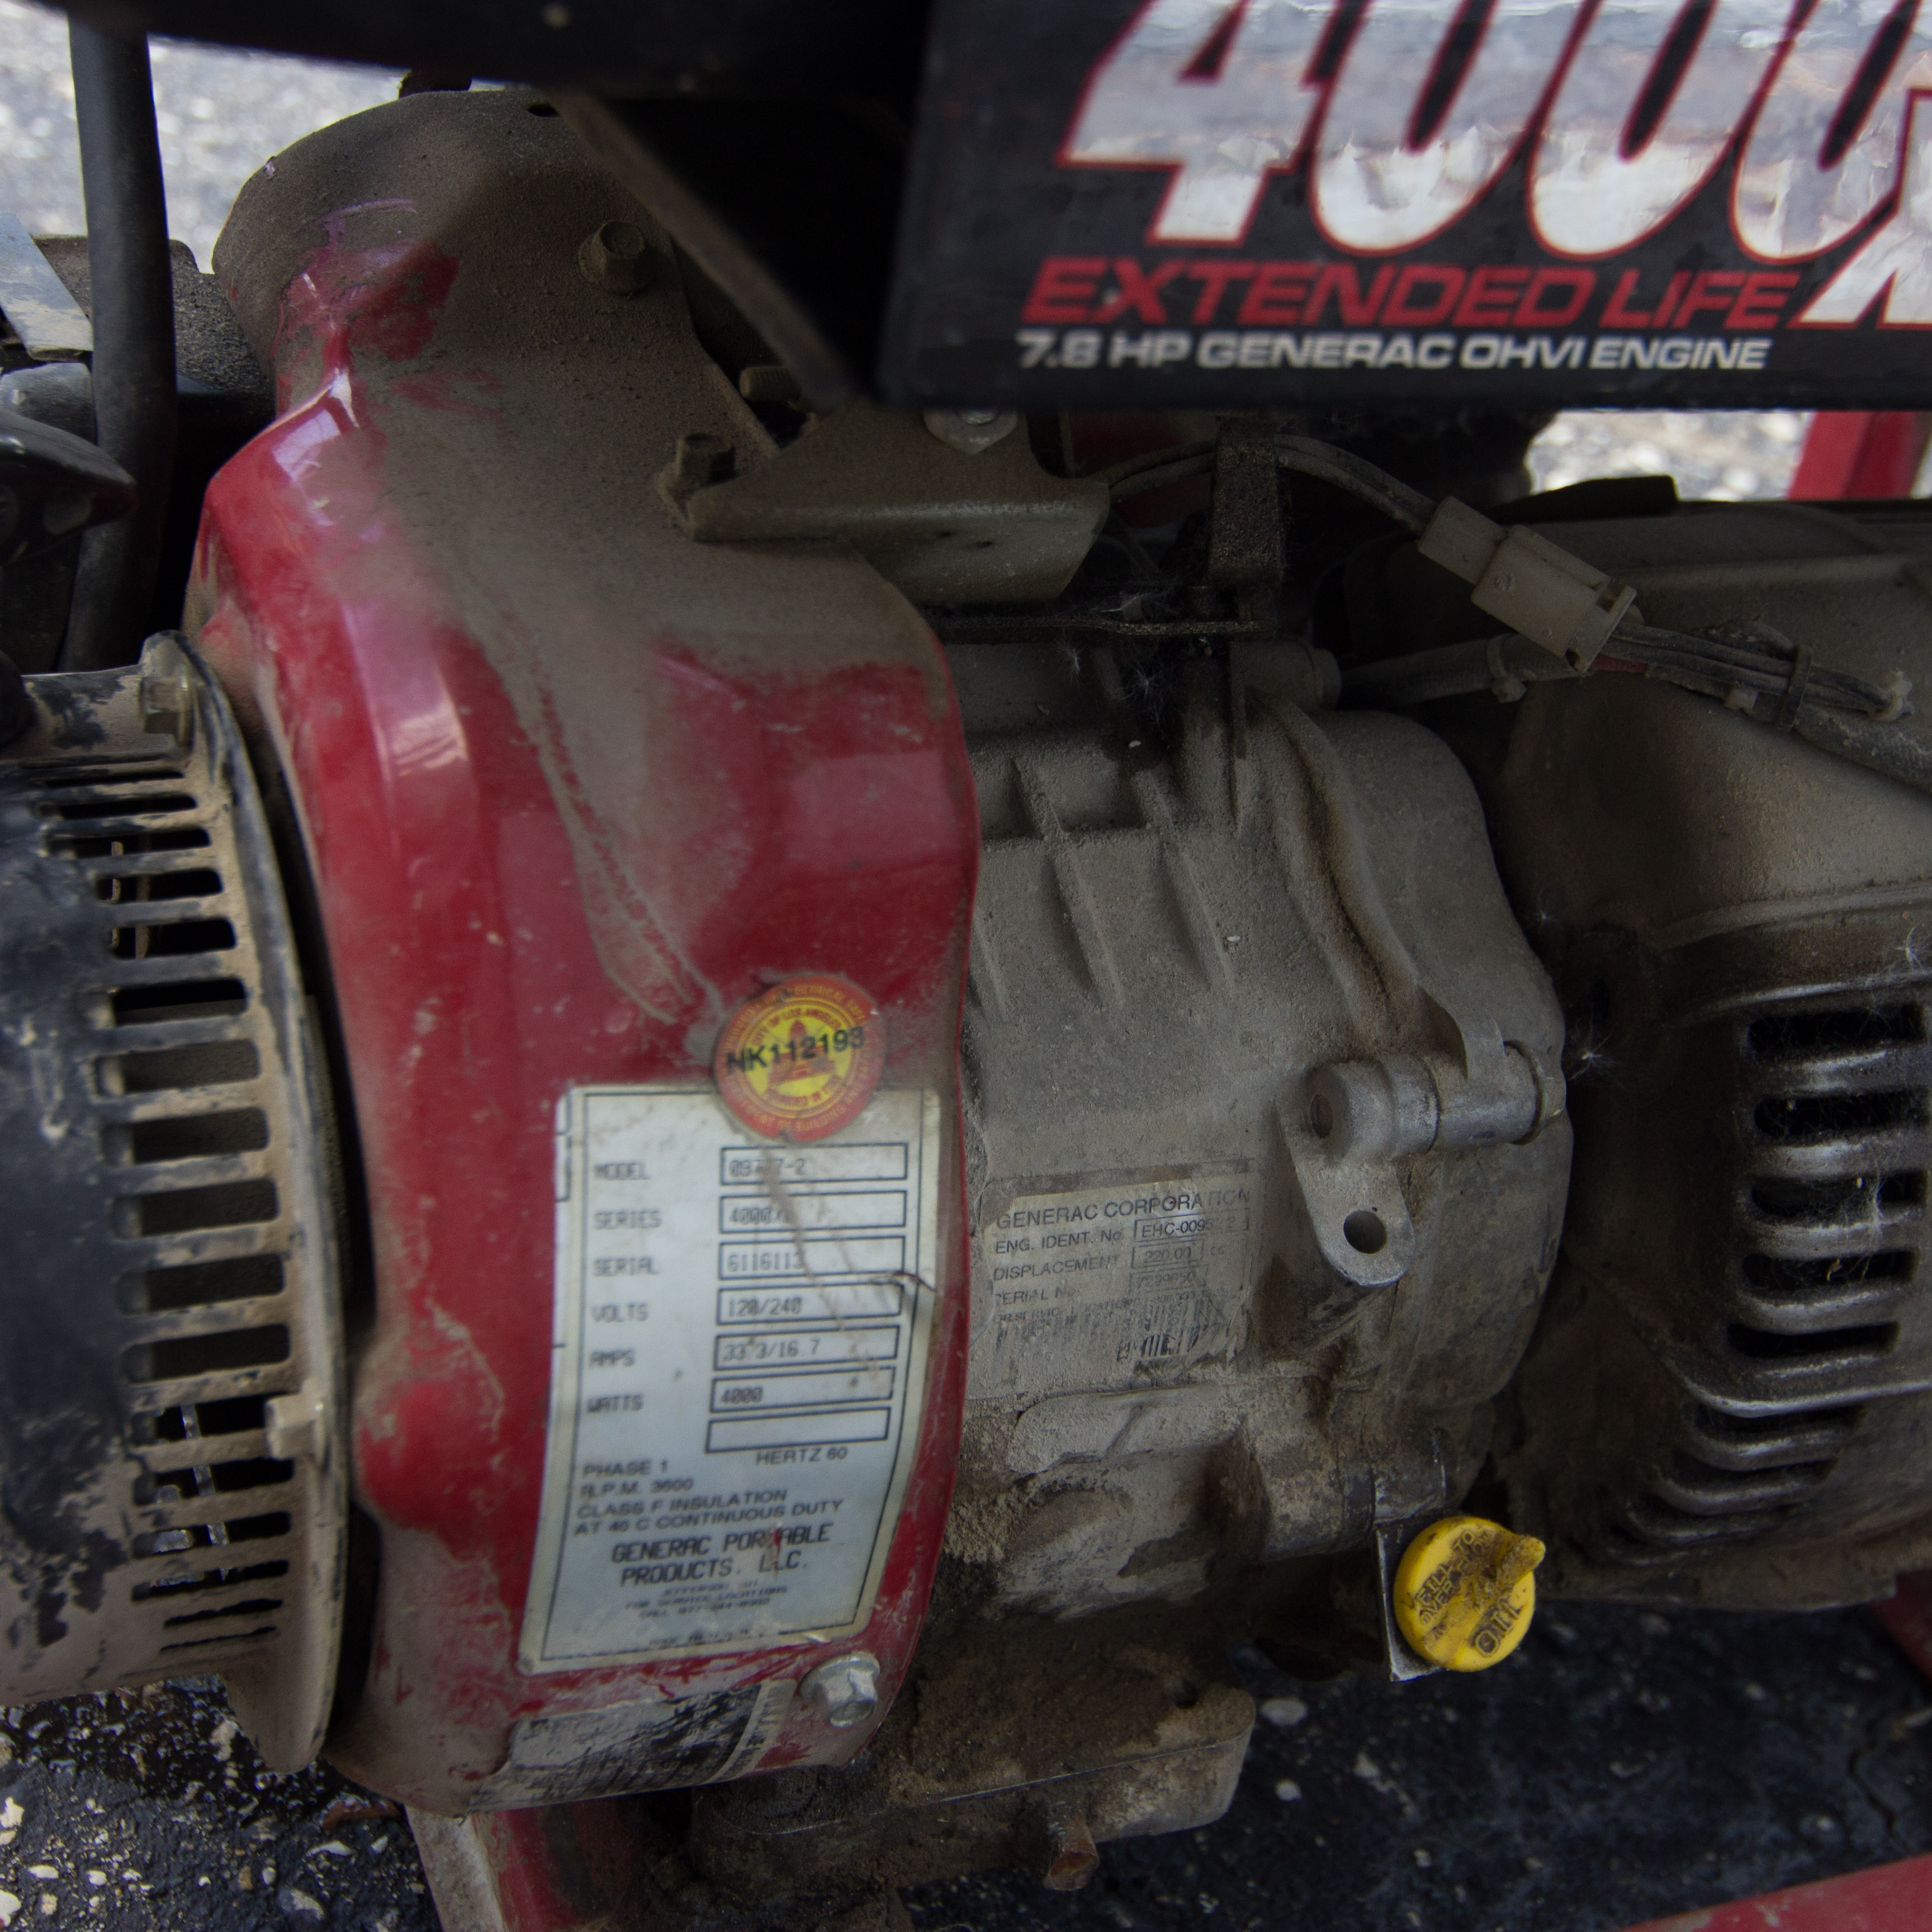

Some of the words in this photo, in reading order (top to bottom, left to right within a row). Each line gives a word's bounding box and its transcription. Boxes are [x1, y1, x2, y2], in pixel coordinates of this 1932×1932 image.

[1021, 254, 1598, 326] EXTENDED
[1599, 268, 1799, 329] LIFE
[1017, 330, 1101, 369] 7.8
[1108, 330, 1191, 369] HP
[1196, 331, 1455, 370] GENERAC
[1460, 334, 1583, 370] OHVI
[1589, 335, 1773, 370] ENGINE
[727, 1026, 866, 1076] NK112193
[594, 1159, 650, 1181] MODEL
[594, 1209, 661, 1230] SERIES
[997, 1204, 1098, 1229] GENERAC
[1104, 1188, 1250, 1218] CORPORATION
[996, 1238, 1034, 1254] ENG.
[1041, 1231, 1093, 1249] IDENT.
[594, 1257, 660, 1277] SERIAL
[993, 1254, 1120, 1281] DISPLACEMENT
[591, 1301, 649, 1323] VOLTS
[728, 1295, 803, 1317] 120/240
[590, 1347, 636, 1367] AMPS
[586, 1394, 644, 1414] WATTS
[721, 1386, 764, 1405] 4000
[756, 1447, 821, 1466] HERTZ
[583, 1460, 652, 1478] PHASE
[577, 1500, 645, 1521] CLASS
[651, 1499, 665, 1514] F
[671, 1489, 788, 1511] INSULATION
[574, 1521, 603, 1537] AT
[635, 1517, 651, 1532] C
[655, 1505, 785, 1530] CONTINUOUS
[791, 1497, 845, 1518] DUTY
[611, 1534, 712, 1564] GENERAC
[722, 1522, 835, 1554] PORABLE
[1413, 1562, 1454, 1608] FILL
[1452, 1531, 1475, 1559] TO
[1475, 1600, 1530, 1658] OIL
